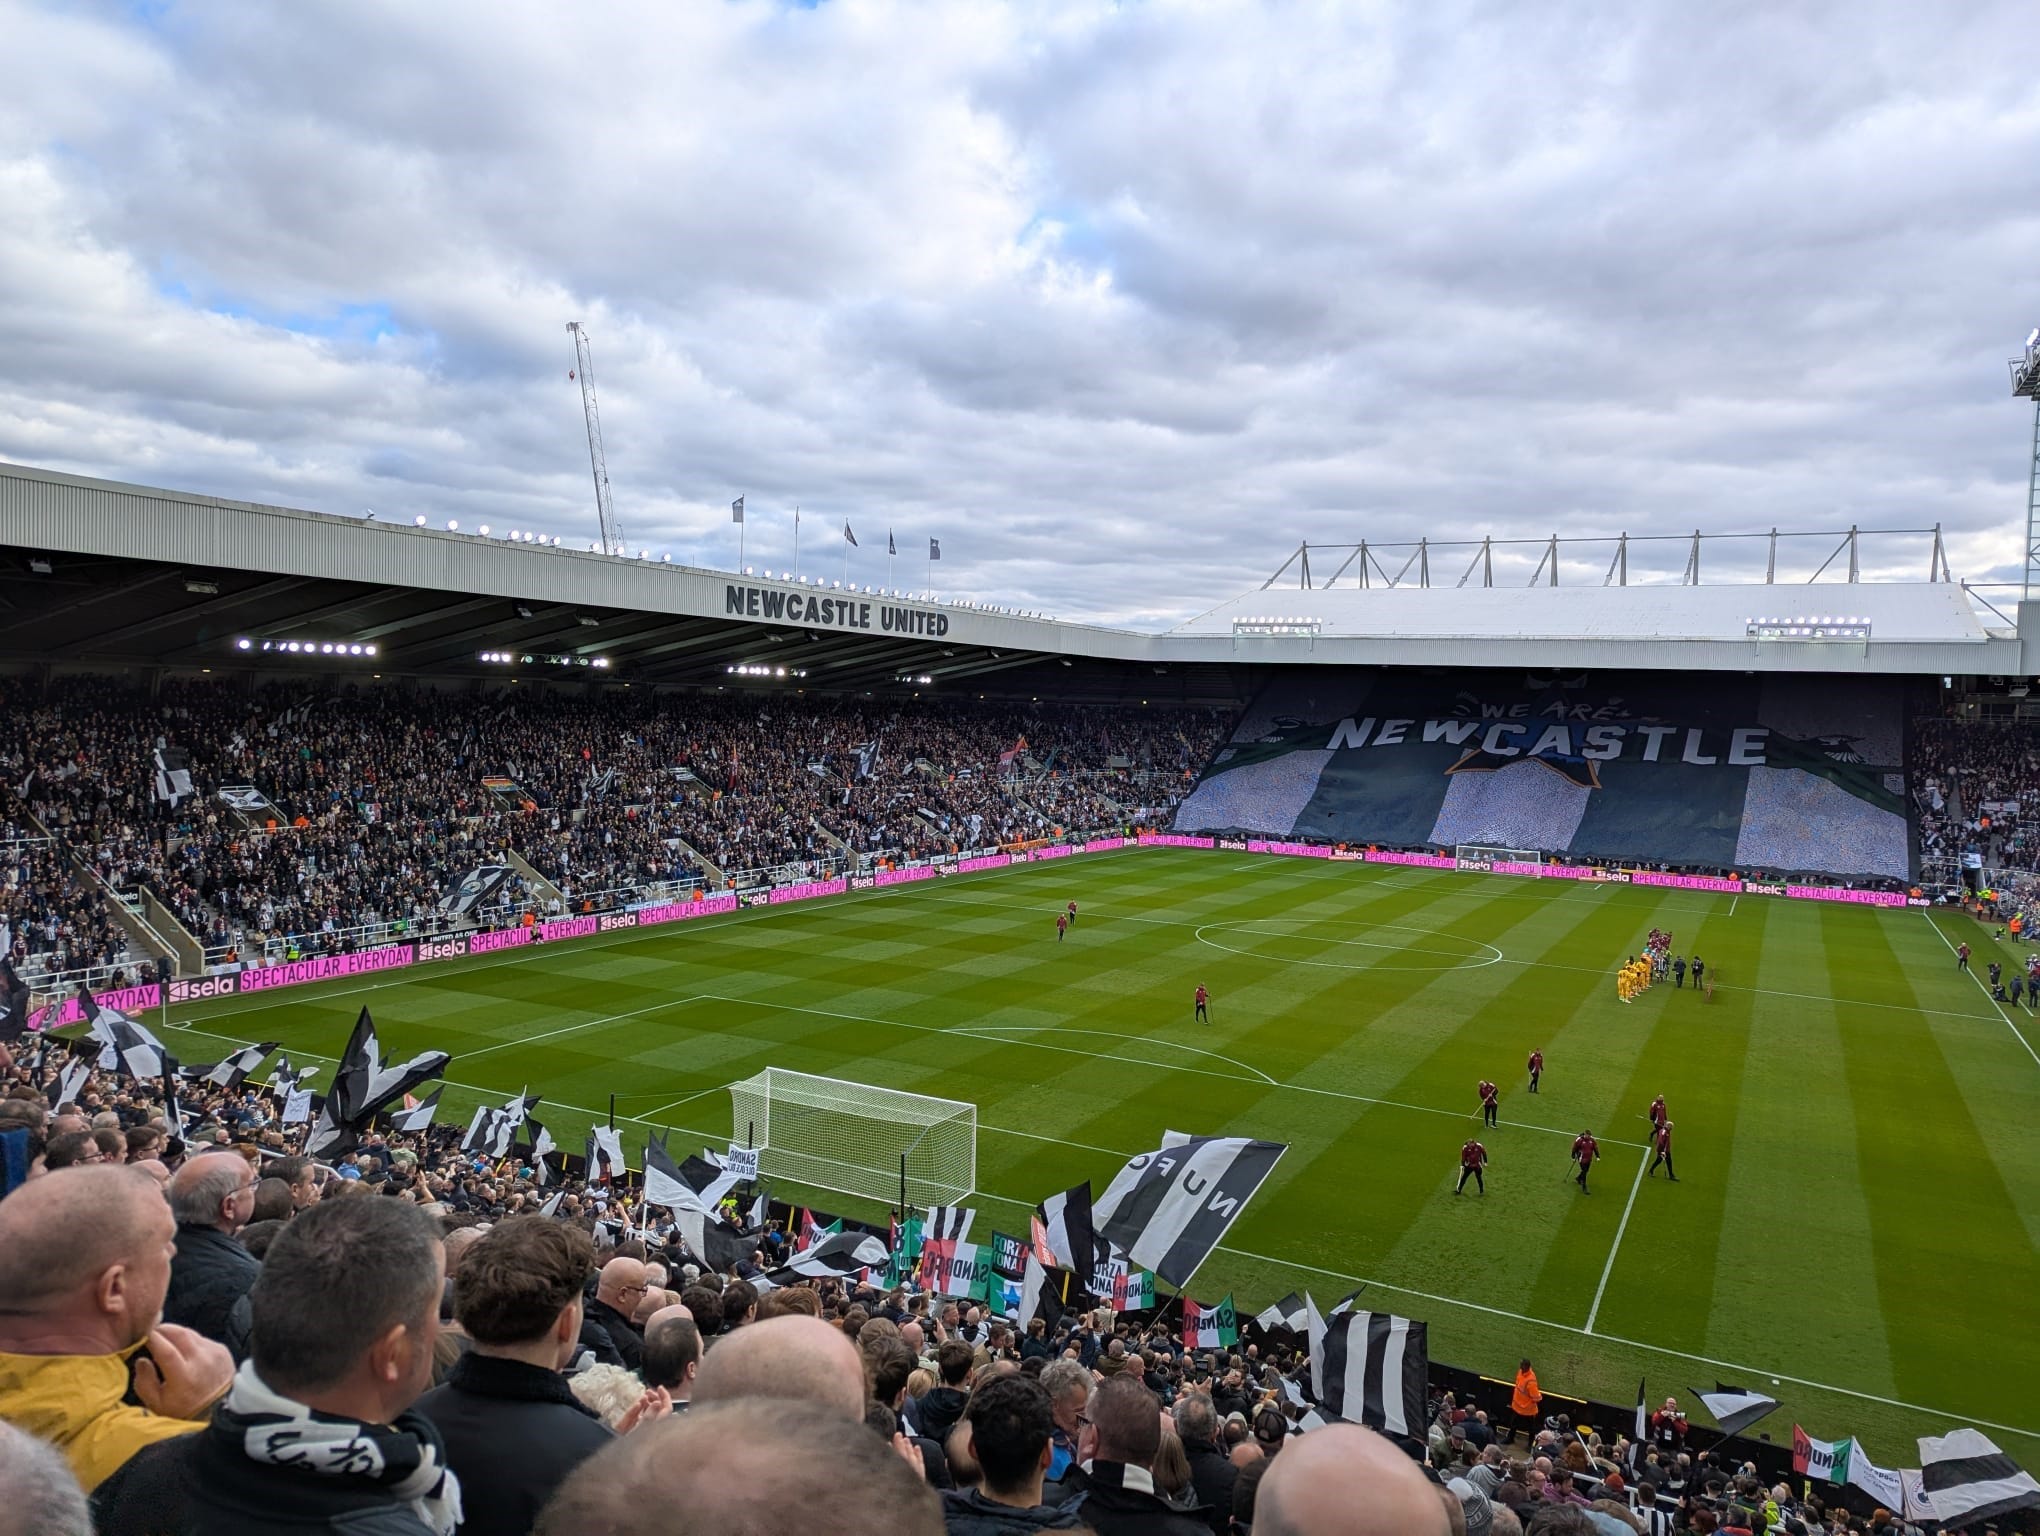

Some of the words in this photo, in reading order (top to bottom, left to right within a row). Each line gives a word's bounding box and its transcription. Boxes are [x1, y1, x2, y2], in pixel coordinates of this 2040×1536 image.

[726, 585, 871, 629] NEWCASTLE
[881, 606, 949, 636] UNITED
[1482, 703, 1531, 718] WE
[1540, 700, 1619, 720] ARE
[1326, 717, 1770, 766] NEWCASTLE
[858, 876, 873, 888] sela
[1607, 872, 1630, 882] sela
[1908, 898, 1930, 907] 00:00
[612, 912, 636, 928] sela
[434, 940, 466, 961] sela
[242, 956, 344, 990] SPECTACULAR.
[349, 947, 411, 973] EVERYDAY.
[189, 978, 234, 998] sela
[77, 986, 158, 1020] EERYDAY.
[994, 1234, 1030, 1257] FORZA
